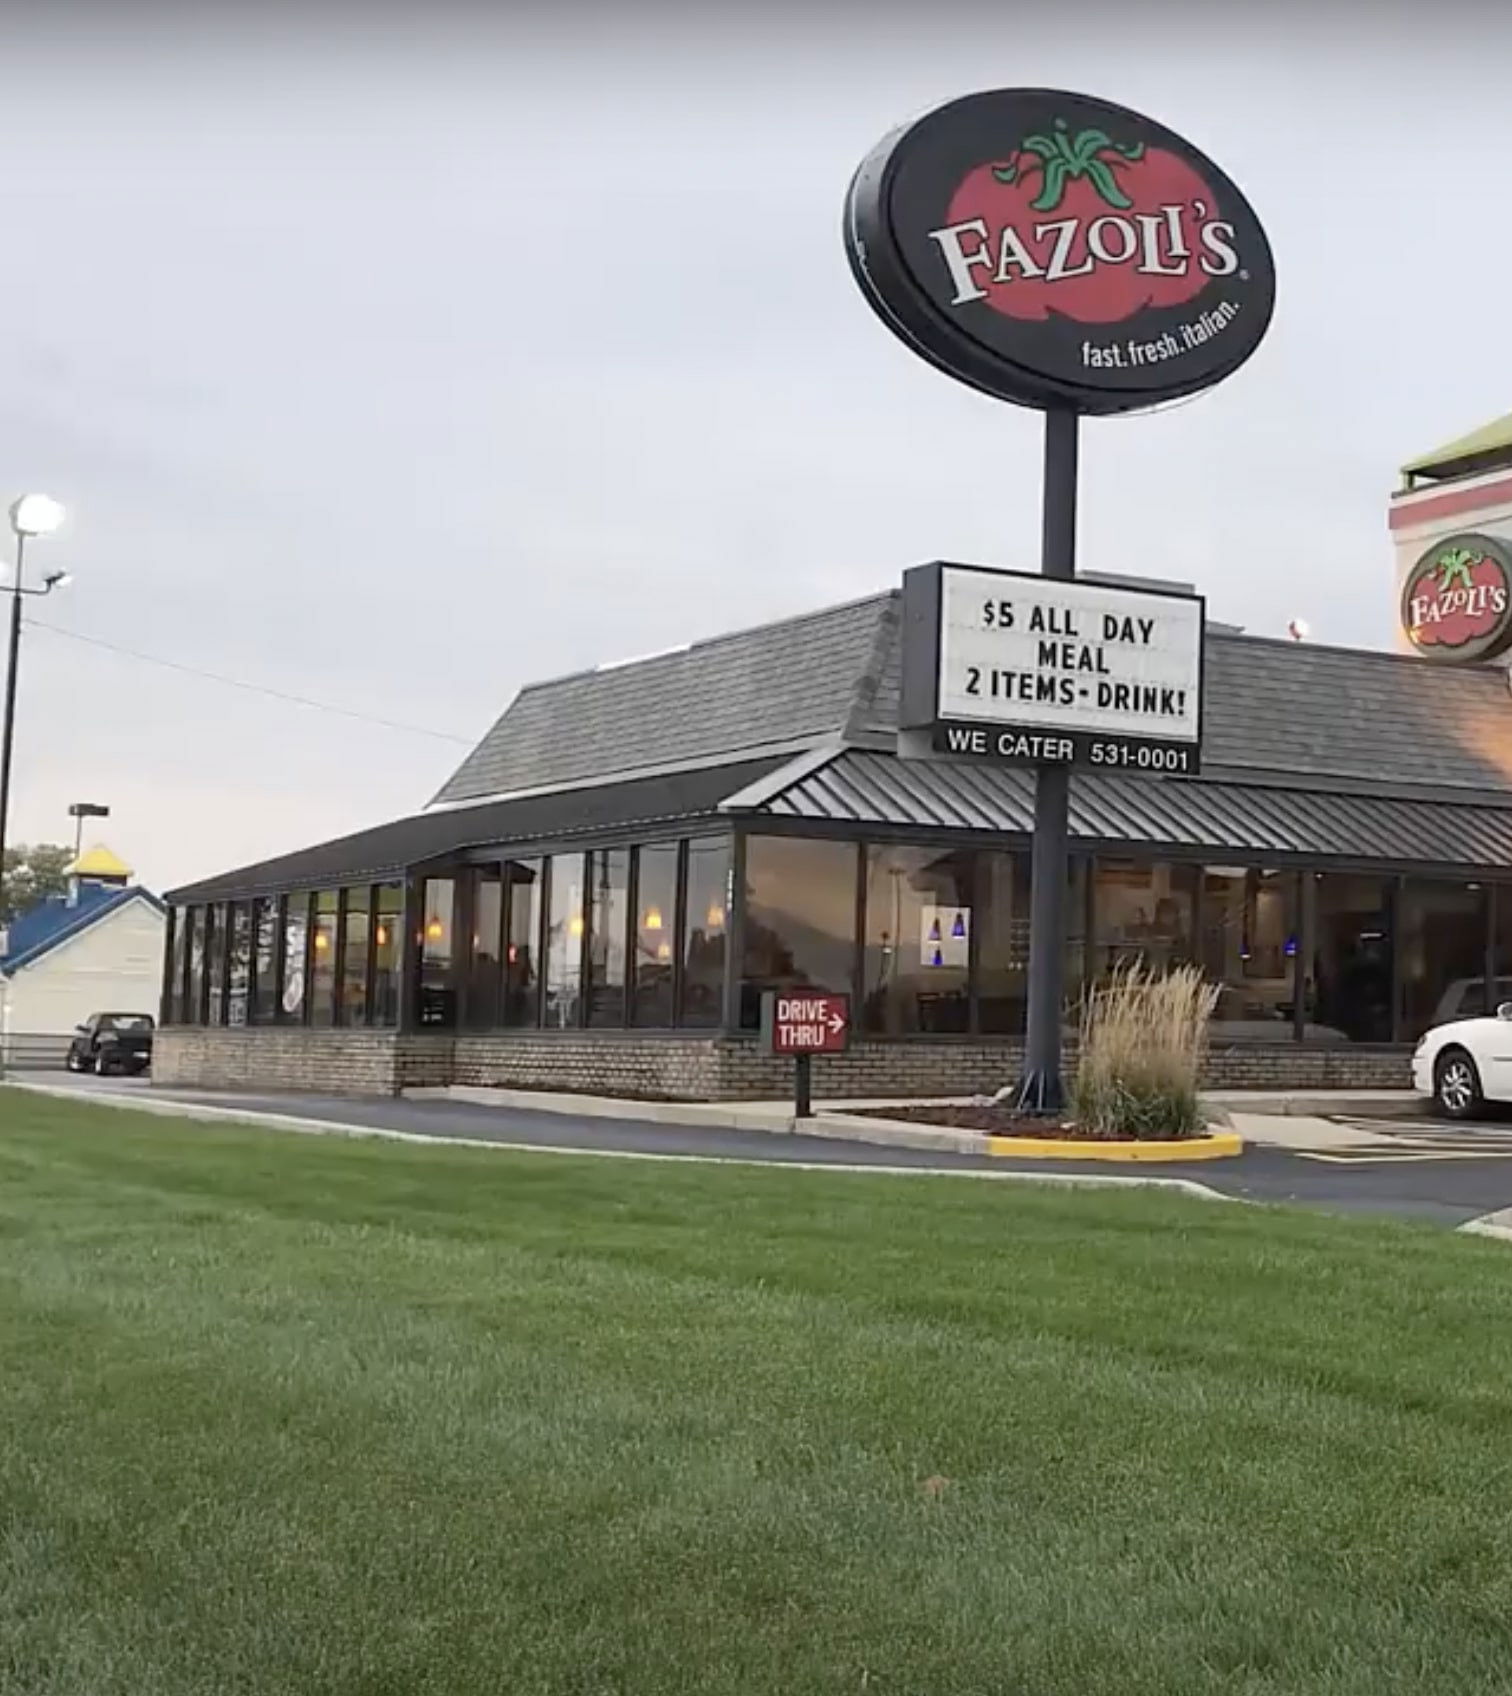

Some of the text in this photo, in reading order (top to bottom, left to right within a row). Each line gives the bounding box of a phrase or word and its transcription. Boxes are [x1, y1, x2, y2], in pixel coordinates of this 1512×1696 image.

[928, 202, 1239, 304] FAZOLI'S
[983, 599, 1154, 645] $5 ALL DAY
[1409, 584, 1507, 629] FAZOLI'S
[1037, 640, 1111, 674] MEAL
[965, 667, 981, 696] 2
[1097, 682, 1187, 716] DRINK!
[948, 729, 1188, 771] WE CATER 531-0001
[777, 999, 828, 1022] DRIVE
[778, 1024, 825, 1047] THRU
